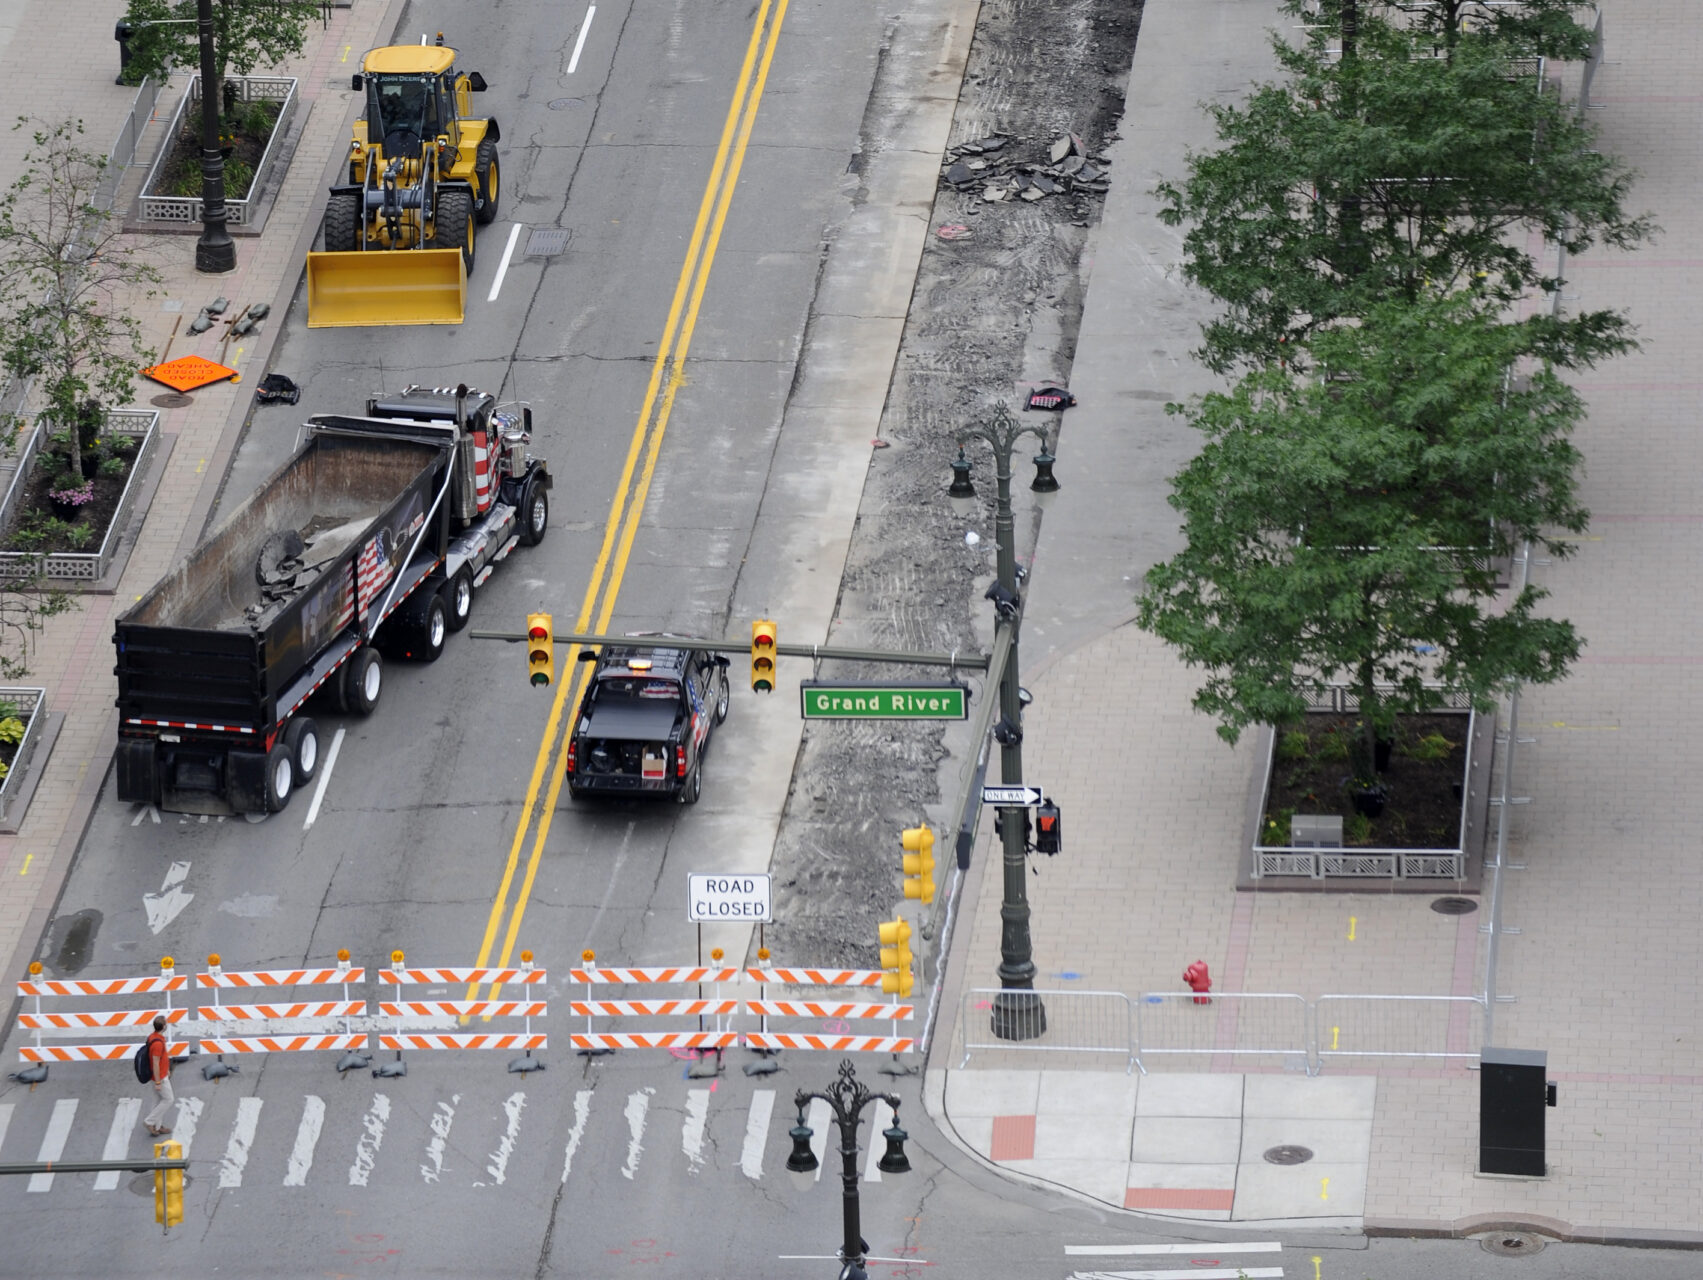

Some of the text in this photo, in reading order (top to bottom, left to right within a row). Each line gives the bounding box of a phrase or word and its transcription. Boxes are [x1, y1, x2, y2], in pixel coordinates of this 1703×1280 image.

[817, 695, 951, 711] Grand River
[987, 791, 1024, 800] ONE WAY
[706, 879, 754, 893] ROAD
[696, 902, 764, 915] CLOSED
